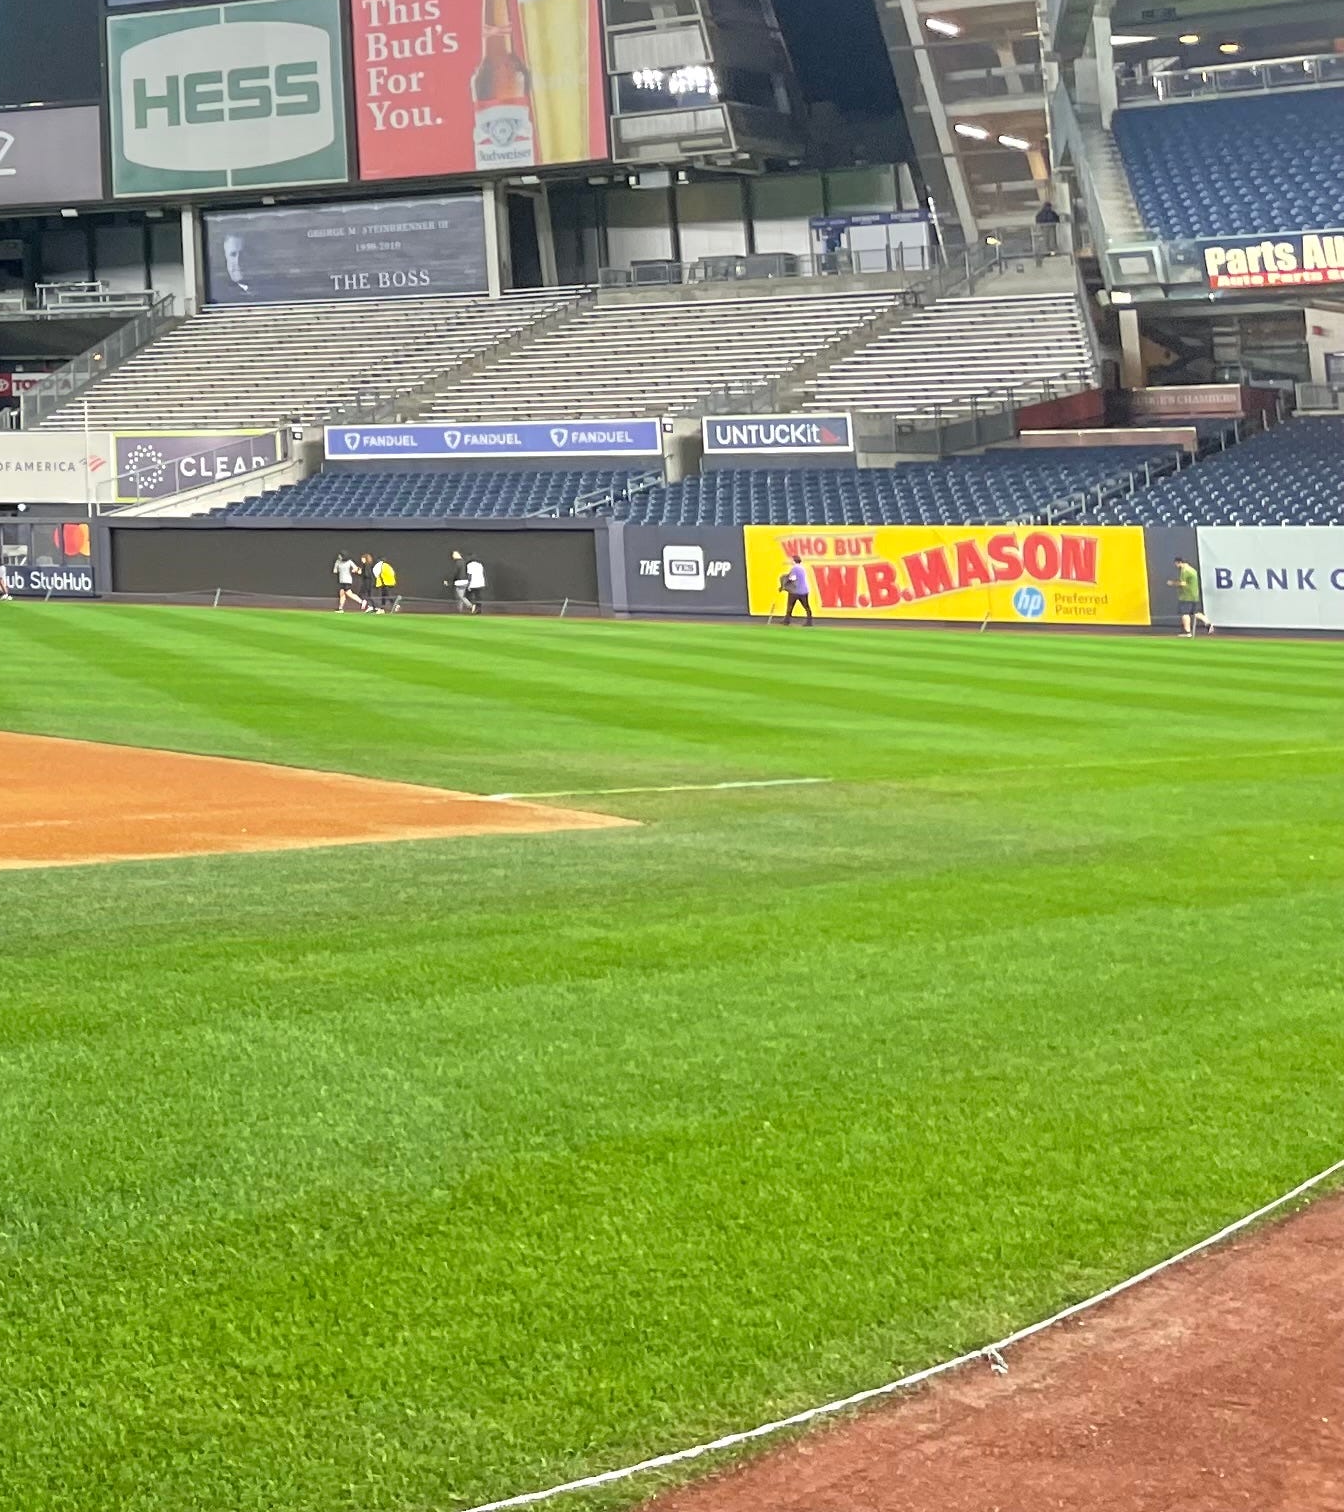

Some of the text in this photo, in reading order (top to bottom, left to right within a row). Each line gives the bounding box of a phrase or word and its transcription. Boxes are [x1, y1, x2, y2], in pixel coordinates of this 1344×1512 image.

[365, 25, 459, 63] Bud's
[366, 67, 424, 97] For
[133, 60, 322, 130] HESS
[366, 100, 444, 132] You.
[1204, 240, 1298, 276] Parts
[329, 269, 431, 291] THE BOSS
[363, 435, 419, 448] FANDUEL
[463, 433, 522, 447] FANDUEL
[570, 430, 633, 445] FANDUEL
[716, 423, 821, 446] UNTUCKit
[15, 461, 76, 472] AMERICA
[782, 536, 873, 557] WHO BUT
[639, 560, 662, 576] THE
[706, 561, 732, 577] APP
[812, 532, 1098, 609] W.B.MASON
[1215, 568, 1318, 590] BANK
[30, 571, 92, 591] StubHub
[1016, 589, 1041, 618] hp
[1055, 593, 1109, 605] Preferred
[1055, 604, 1098, 616] Partner
